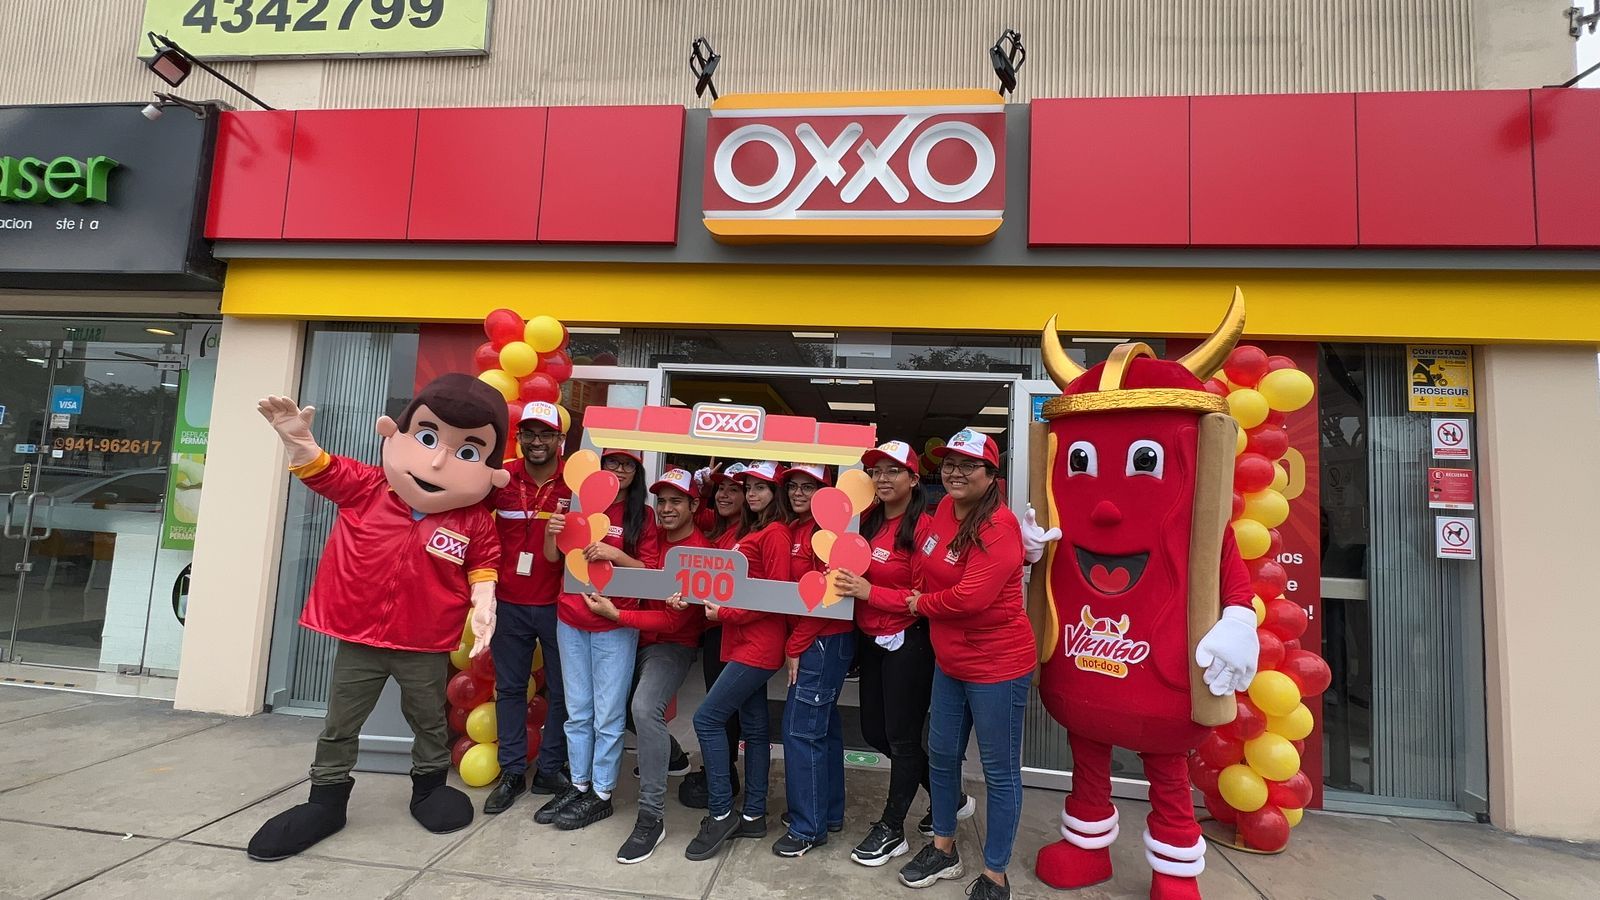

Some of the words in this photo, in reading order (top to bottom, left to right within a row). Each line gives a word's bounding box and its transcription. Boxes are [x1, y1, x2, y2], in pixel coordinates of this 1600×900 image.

[182, 0, 444, 34] 4342799
[713, 115, 996, 214] OXXO
[1412, 348, 1467, 356] CONECTADA
[1413, 387, 1469, 396] PROSEGUR
[58, 401, 77, 409] VISA
[530, 407, 551, 416] 100
[698, 413, 757, 433] OXXO
[65, 437, 162, 455] 941-962617
[432, 534, 467, 559] OXX
[678, 553, 736, 571] TIENDA
[675, 569, 735, 603] 100
[1065, 621, 1150, 665] VIKINGO
[1082, 657, 1120, 674] hot-dog
